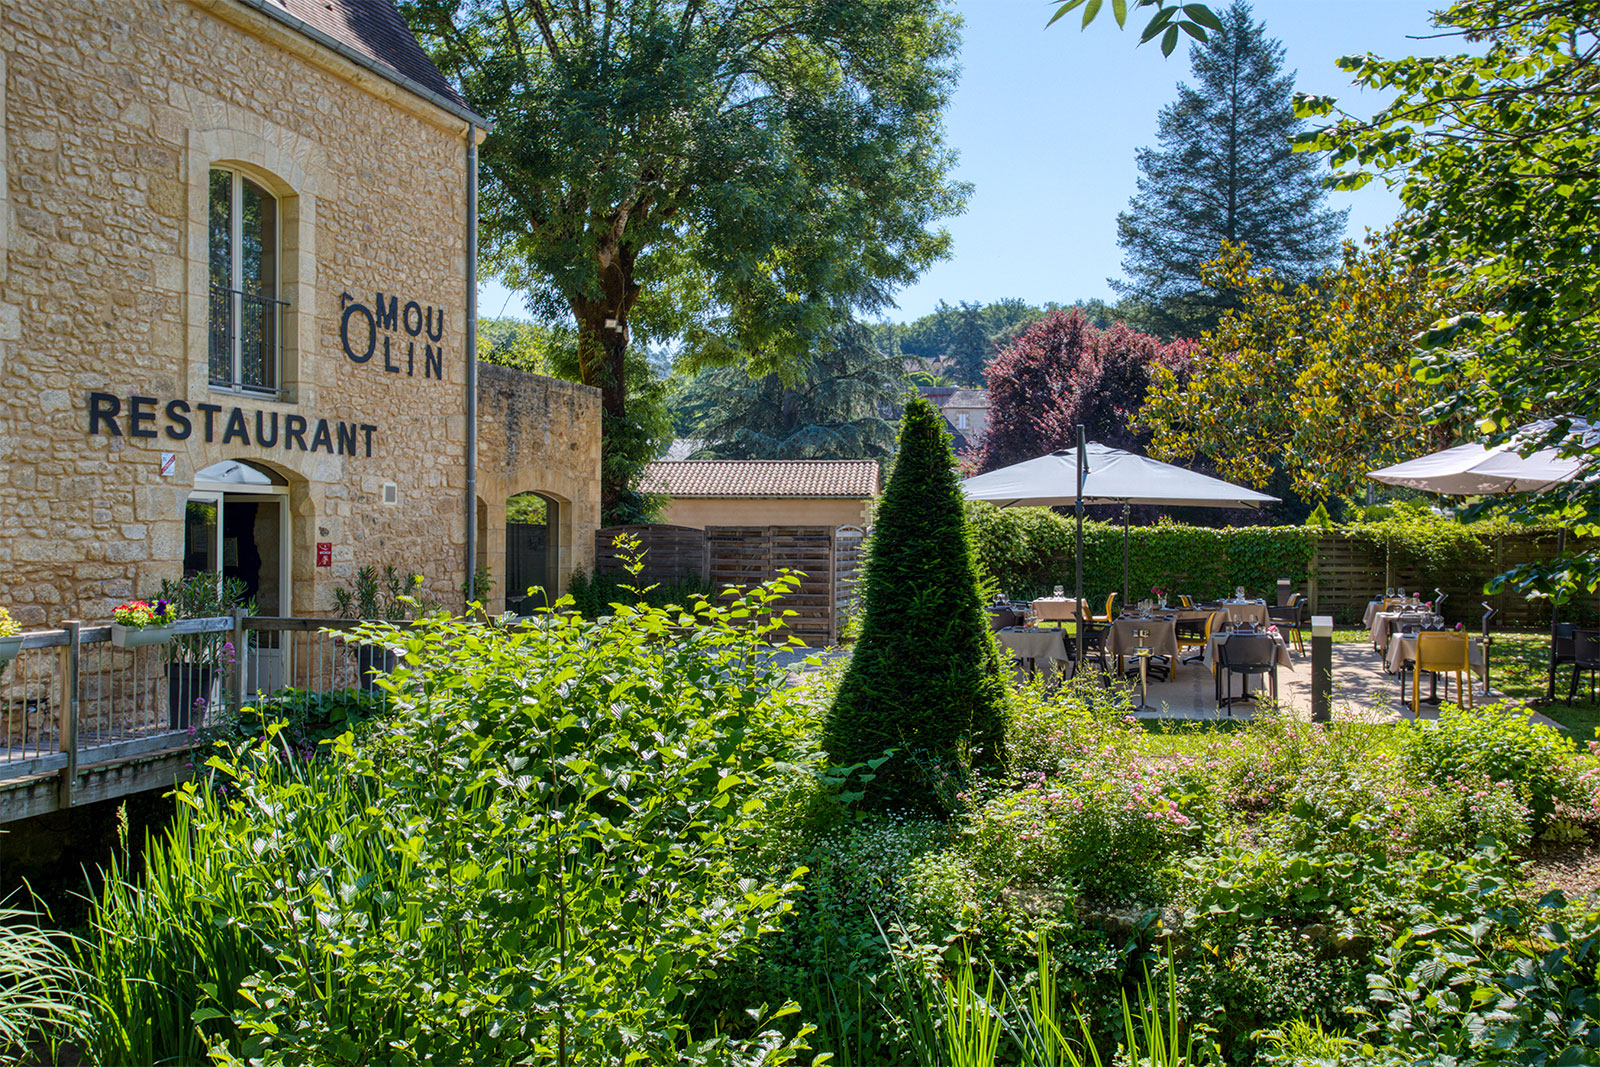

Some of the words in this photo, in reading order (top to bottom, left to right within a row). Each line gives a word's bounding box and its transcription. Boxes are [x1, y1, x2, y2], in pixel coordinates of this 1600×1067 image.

[376, 292, 443, 342] MOU
[384, 336, 442, 380] LIN
[89, 392, 377, 457] RESTAURANT
